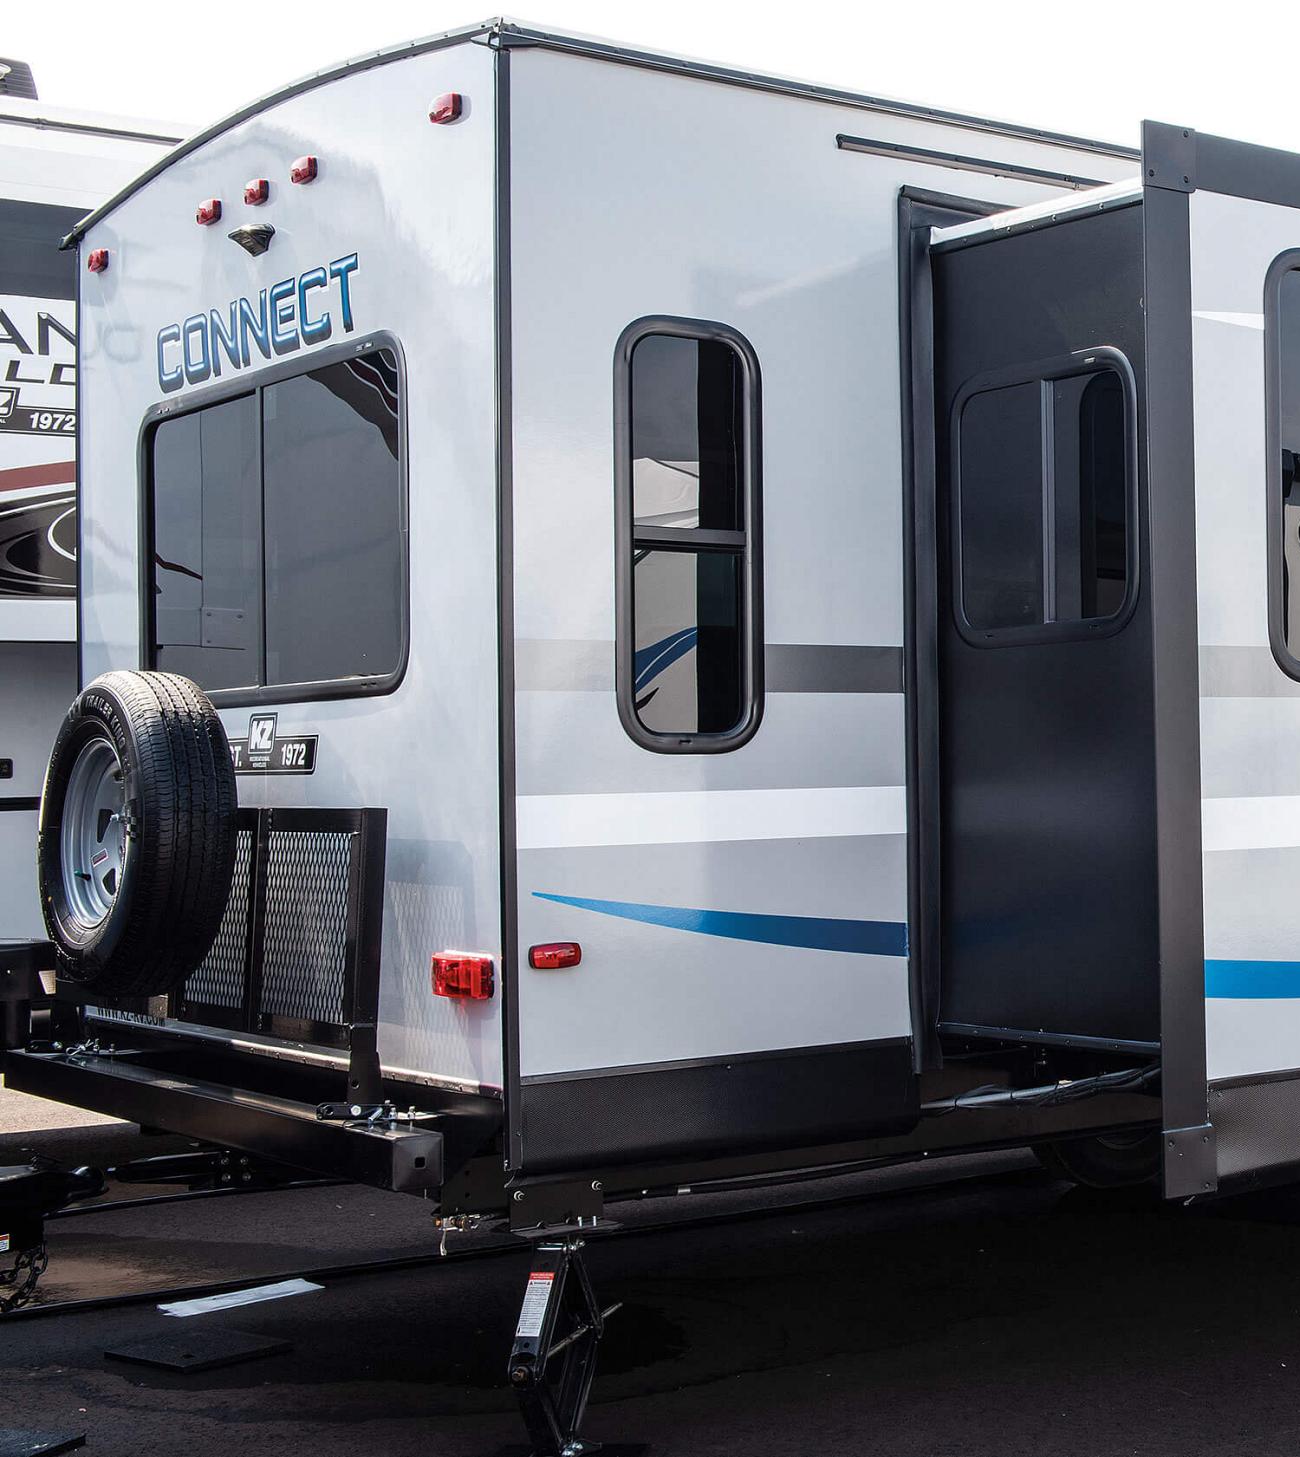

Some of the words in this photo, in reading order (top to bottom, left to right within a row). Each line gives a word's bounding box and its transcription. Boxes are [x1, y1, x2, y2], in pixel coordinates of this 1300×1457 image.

[157, 252, 358, 394] CONNECT
[30, 411, 76, 431] 1972
[250, 720, 274, 750] KZ
[281, 742, 306, 766] 1972
